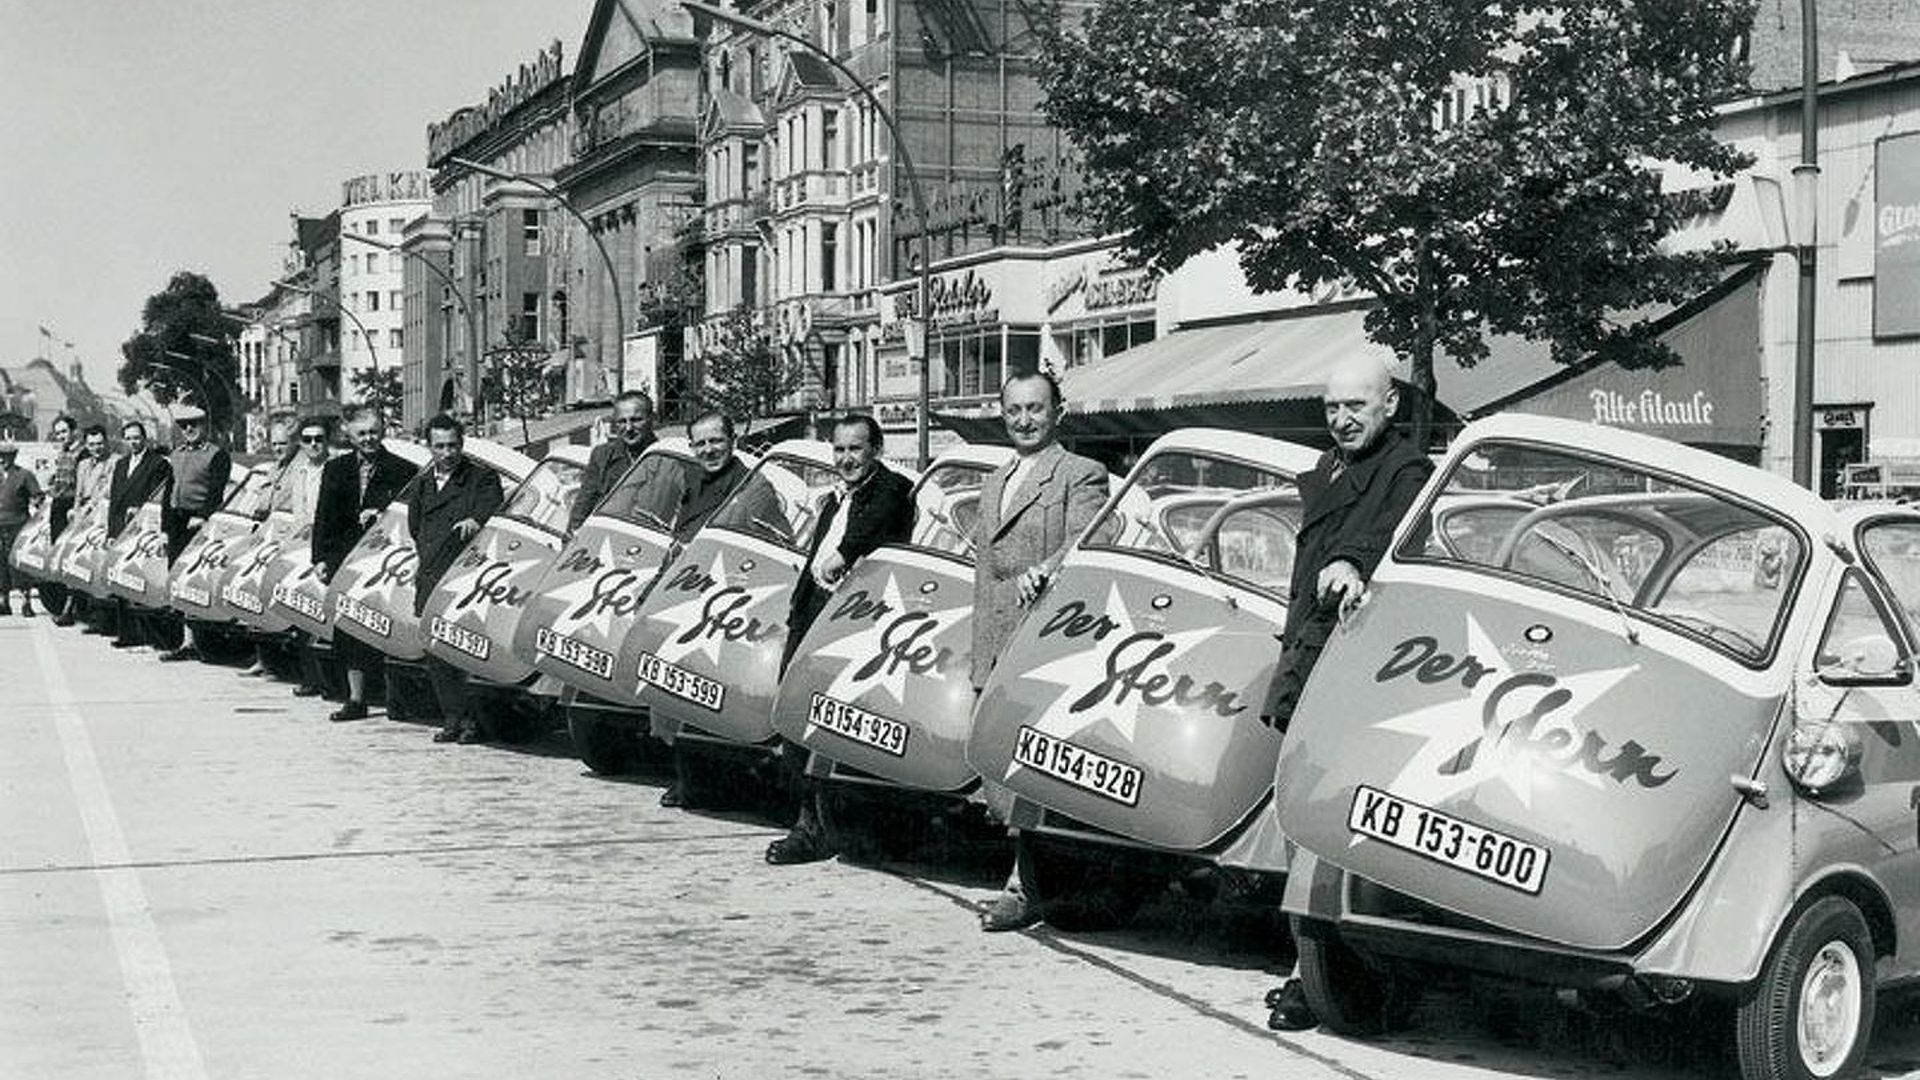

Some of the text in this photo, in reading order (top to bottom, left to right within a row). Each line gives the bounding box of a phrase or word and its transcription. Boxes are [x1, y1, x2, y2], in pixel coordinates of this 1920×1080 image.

[1589, 389, 1637, 424] Alte
[364, 546, 417, 588] Ste
[558, 548, 606, 574] Der
[664, 564, 718, 593] Der
[569, 569, 641, 621] Ste
[829, 590, 895, 623] Der
[1038, 600, 1121, 641] Der
[640, 656, 720, 705] KB 153-599
[1068, 631, 1248, 715] Stern
[1375, 635, 1498, 689] Der
[1437, 672, 1681, 789] Stern
[1359, 791, 1538, 885] KB 153-600
